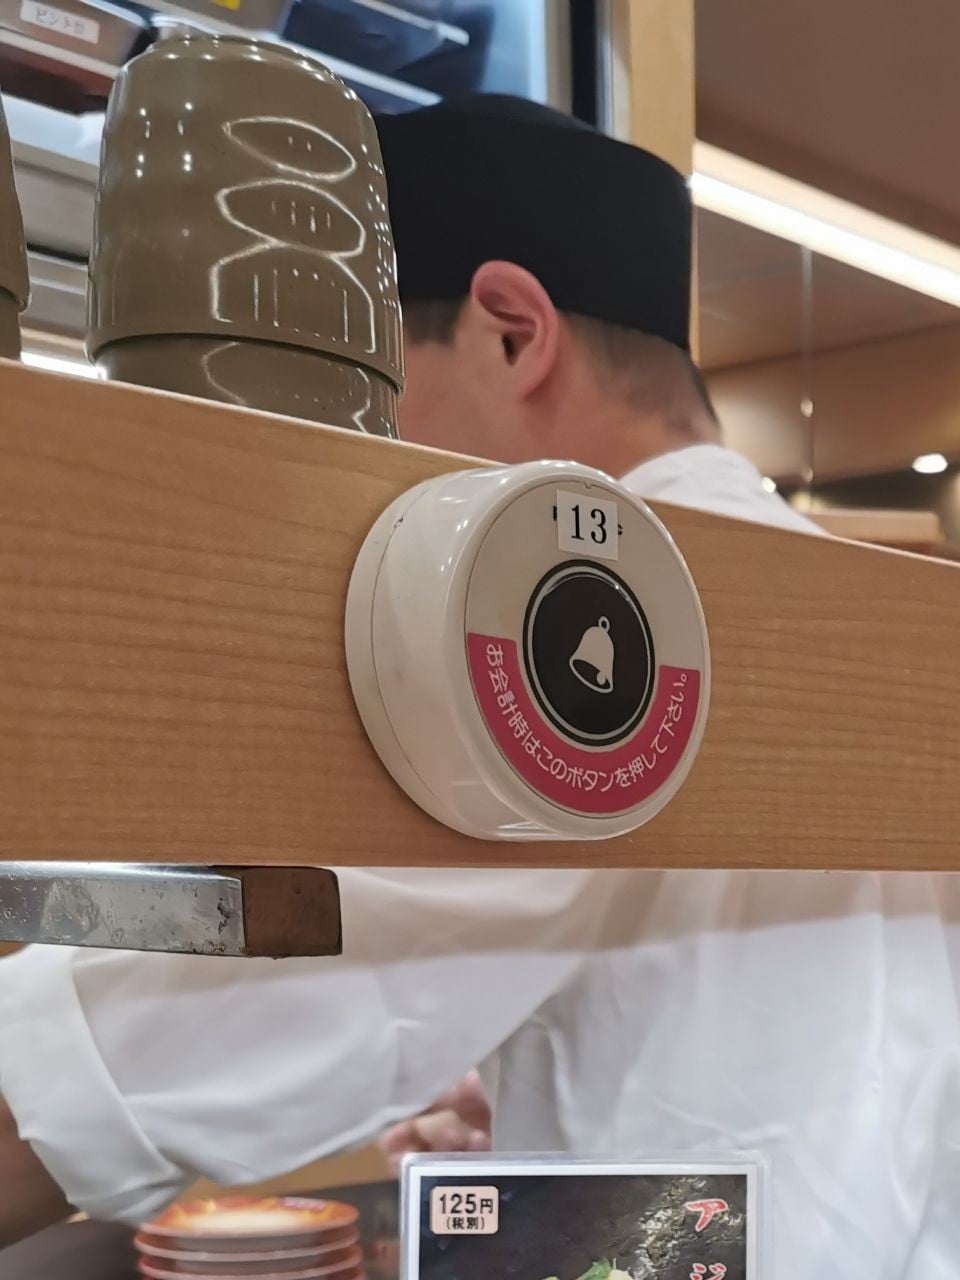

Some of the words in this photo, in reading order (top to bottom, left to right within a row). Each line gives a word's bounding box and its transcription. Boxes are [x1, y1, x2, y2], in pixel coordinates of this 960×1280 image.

[571, 505, 608, 544] 13
[486, 643, 688, 792] お会計時はこのボタンを押して下さい。
[439, 1193, 495, 1216] 125円
